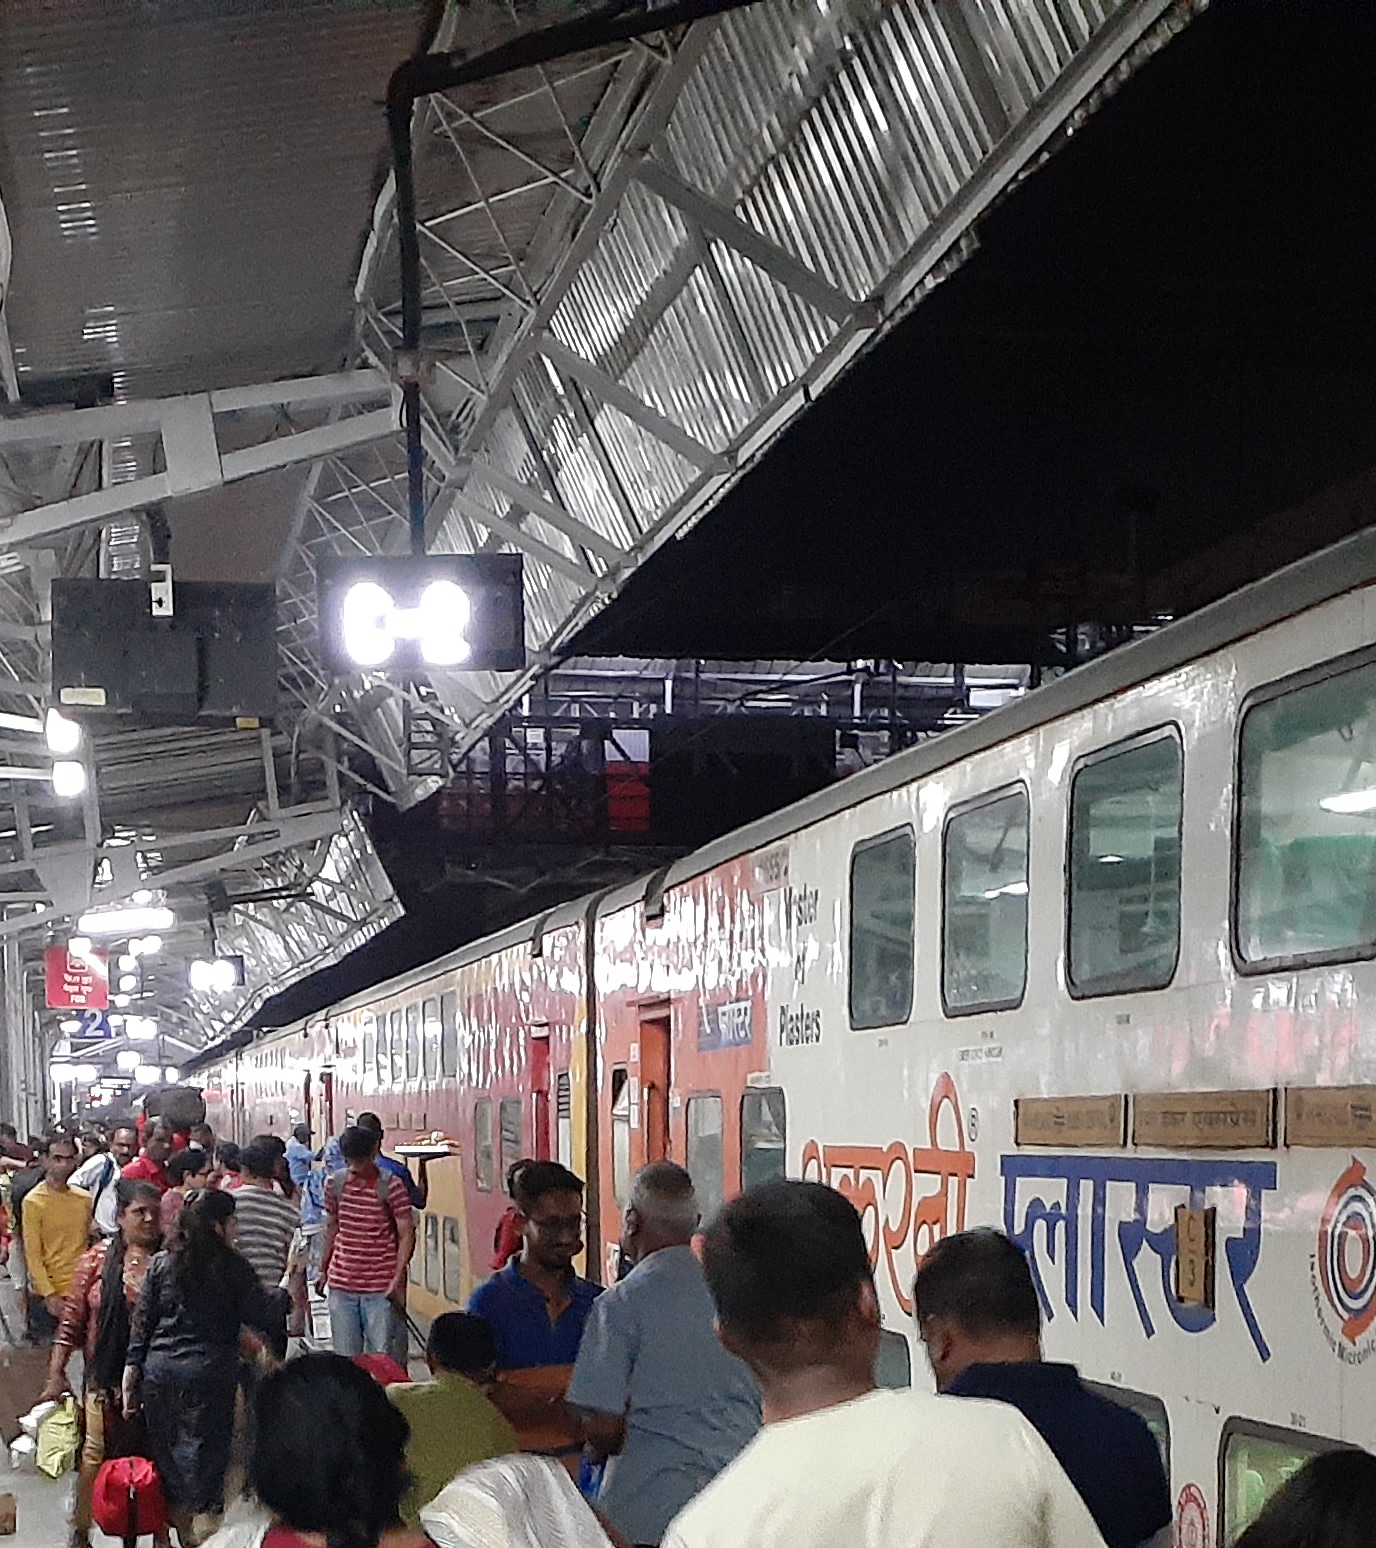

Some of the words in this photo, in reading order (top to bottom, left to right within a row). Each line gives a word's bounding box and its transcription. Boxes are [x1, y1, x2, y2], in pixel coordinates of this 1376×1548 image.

[782, 883, 820, 931] Mster
[84, 1009, 104, 1037] 2
[778, 1002, 822, 1047] Plasters
